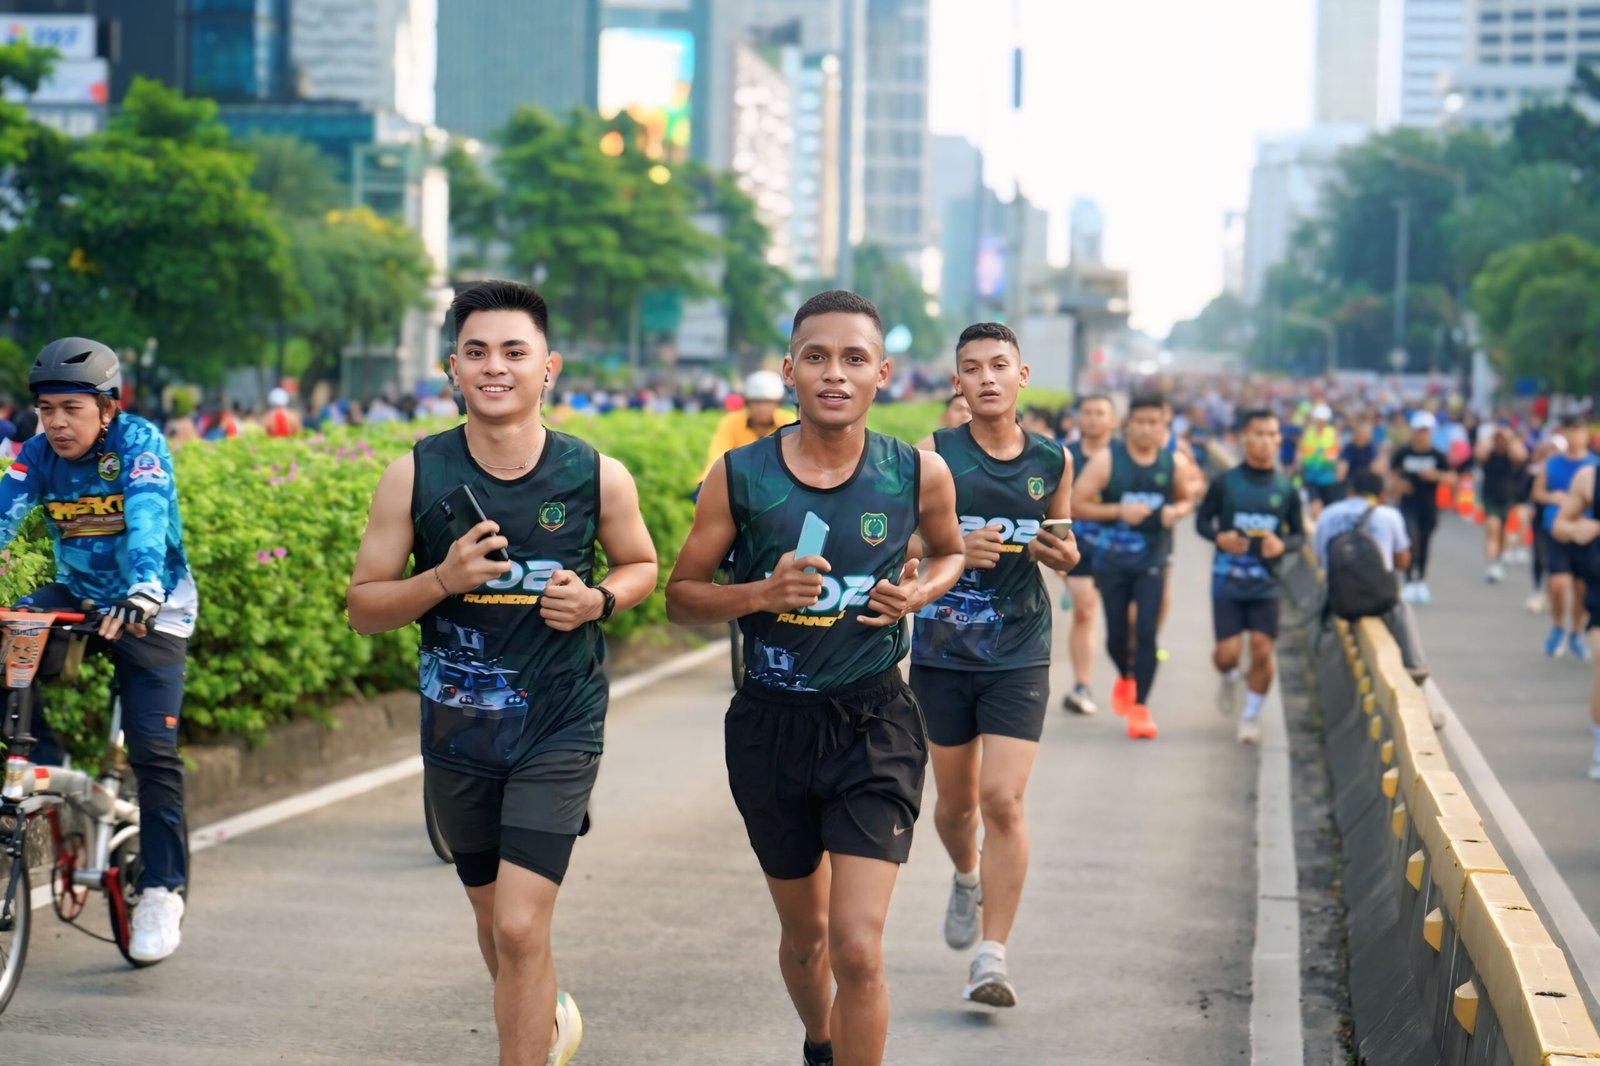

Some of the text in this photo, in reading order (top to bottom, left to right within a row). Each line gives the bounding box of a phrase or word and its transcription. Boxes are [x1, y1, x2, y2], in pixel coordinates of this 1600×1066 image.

[485, 560, 564, 590] 02
[463, 593, 539, 605] RUNNERS
[764, 572, 876, 611] 02
